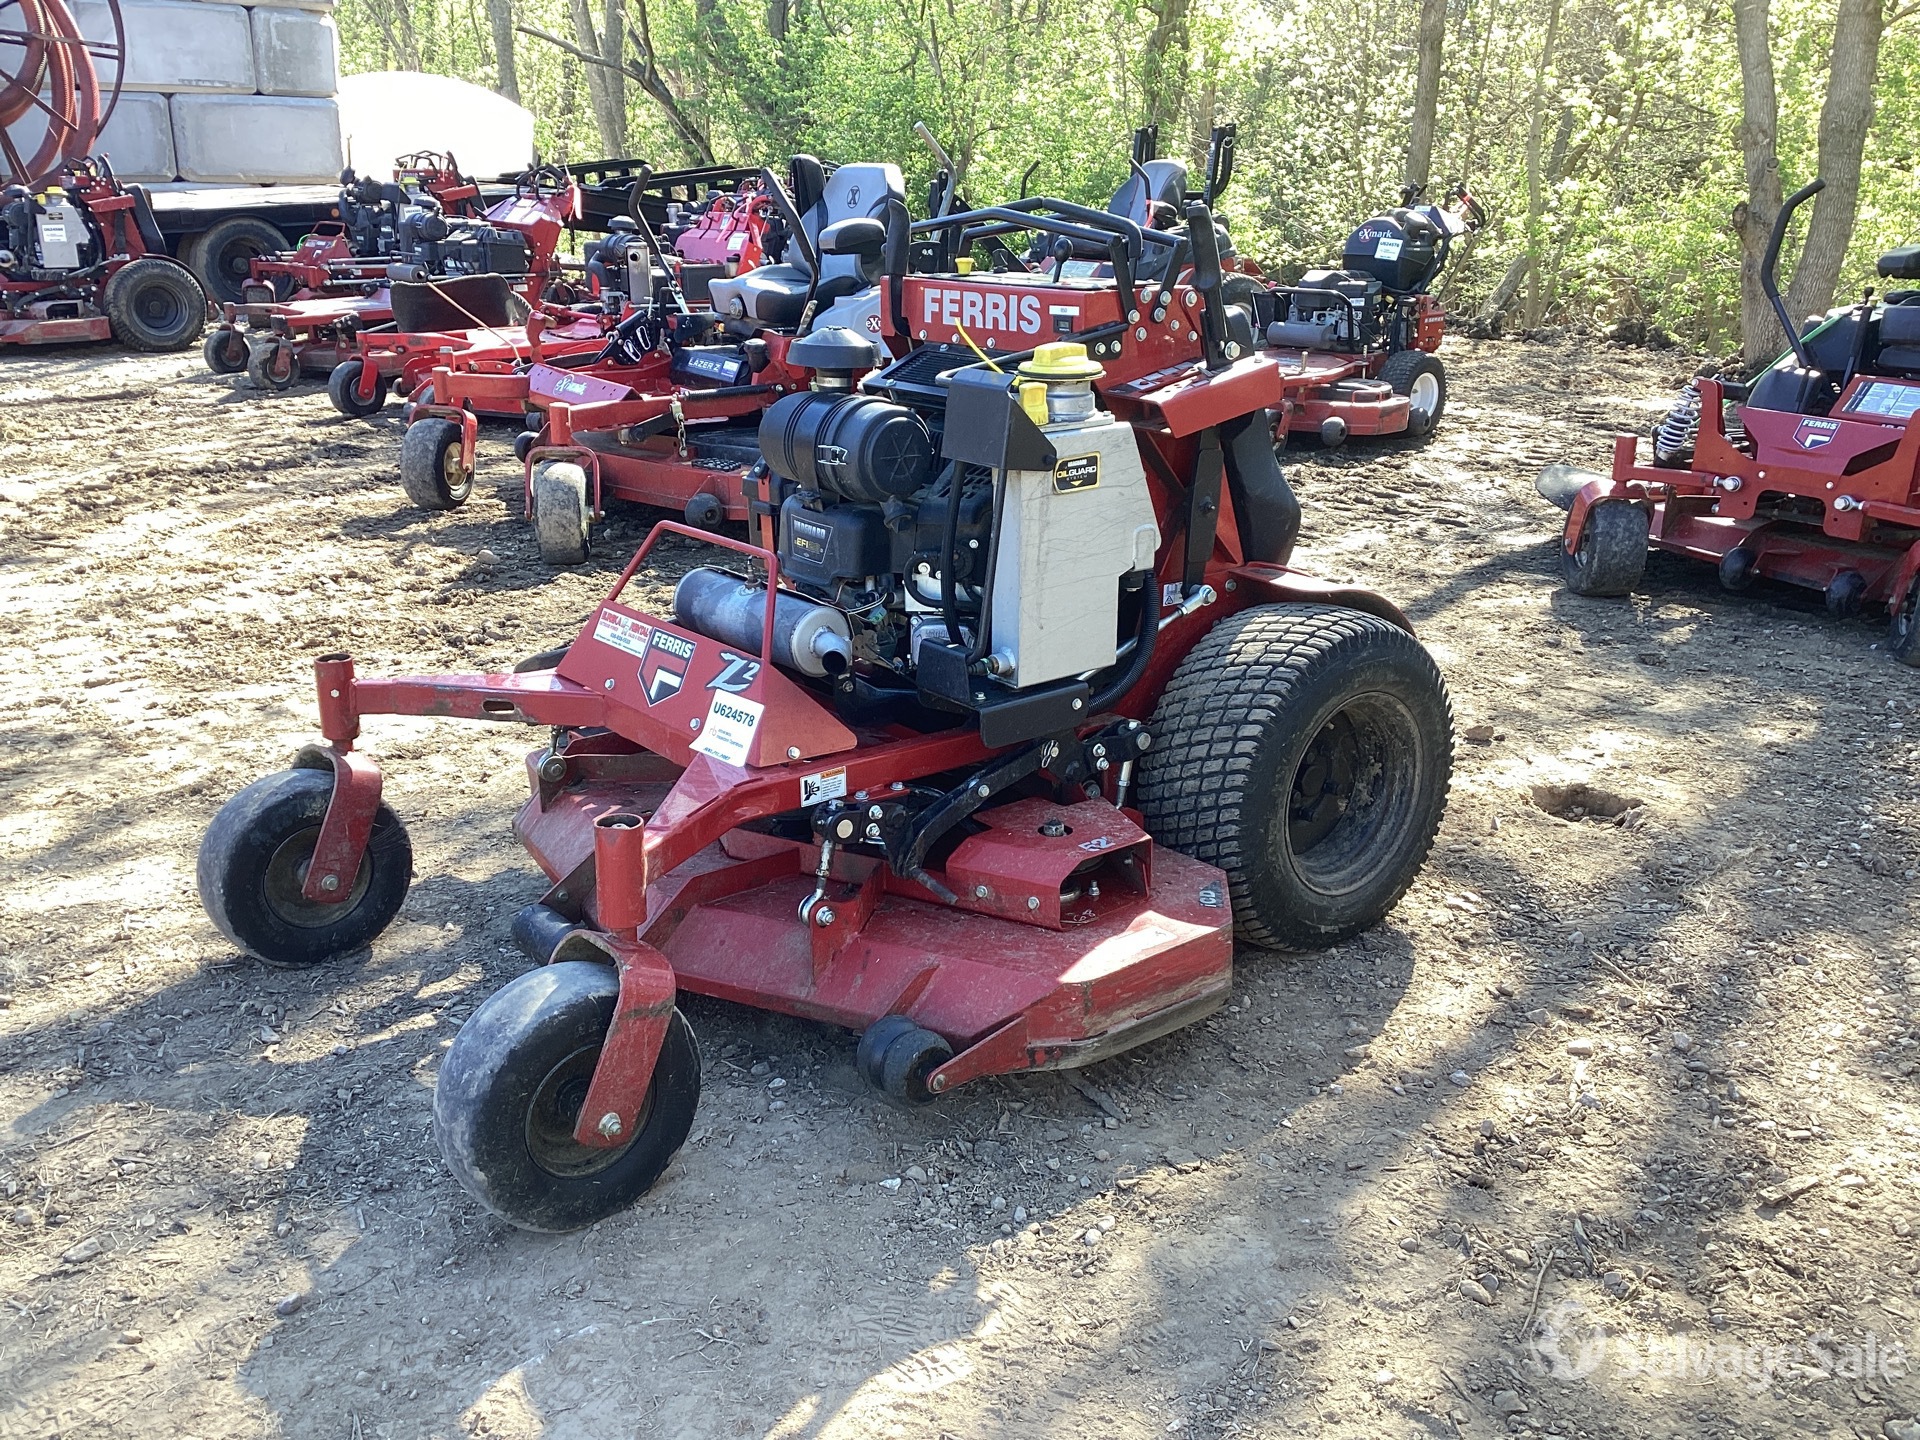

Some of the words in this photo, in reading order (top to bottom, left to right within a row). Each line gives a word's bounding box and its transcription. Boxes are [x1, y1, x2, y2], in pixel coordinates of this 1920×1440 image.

[1358, 228, 1393, 240] eXmark
[924, 287, 1041, 335] FERRIS
[865, 317, 881, 331] eX
[688, 357, 714, 370] LAZER
[713, 363, 721, 372] Z
[1802, 419, 1838, 430] FERRIS
[1056, 465, 1097, 478] OILGUARD
[651, 631, 693, 658] FERRIS
[713, 701, 755, 727] U624578
